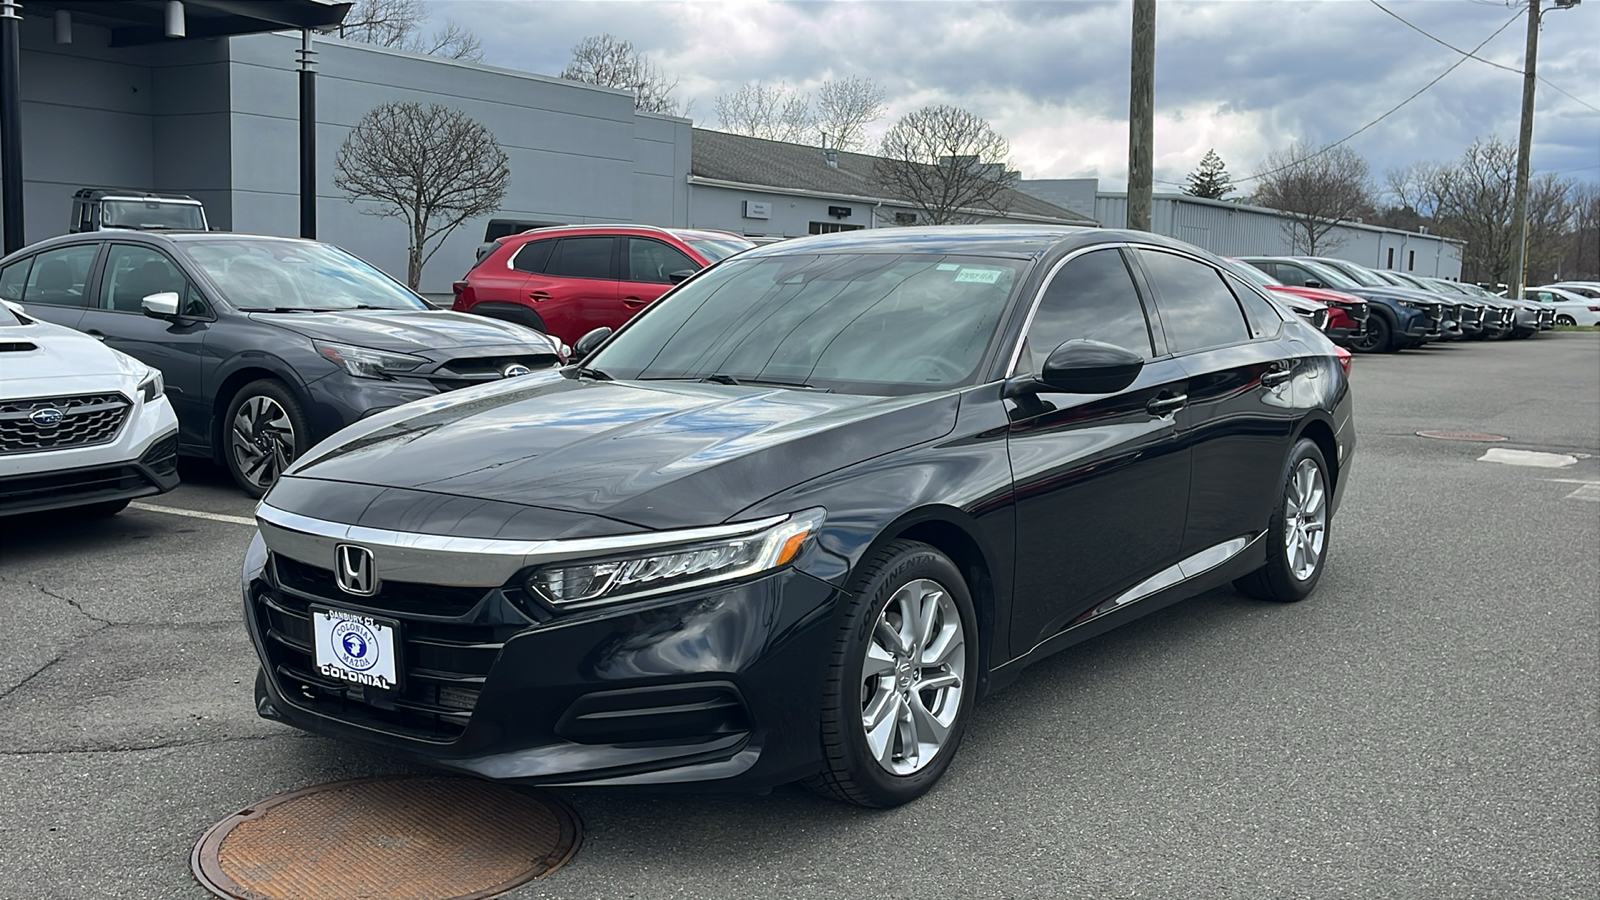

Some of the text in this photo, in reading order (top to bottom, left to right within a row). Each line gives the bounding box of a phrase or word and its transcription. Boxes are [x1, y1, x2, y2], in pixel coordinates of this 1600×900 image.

[336, 623, 373, 645] COLONIAL
[342, 653, 371, 668] MAZDA
[321, 665, 391, 690] COLONIAL
